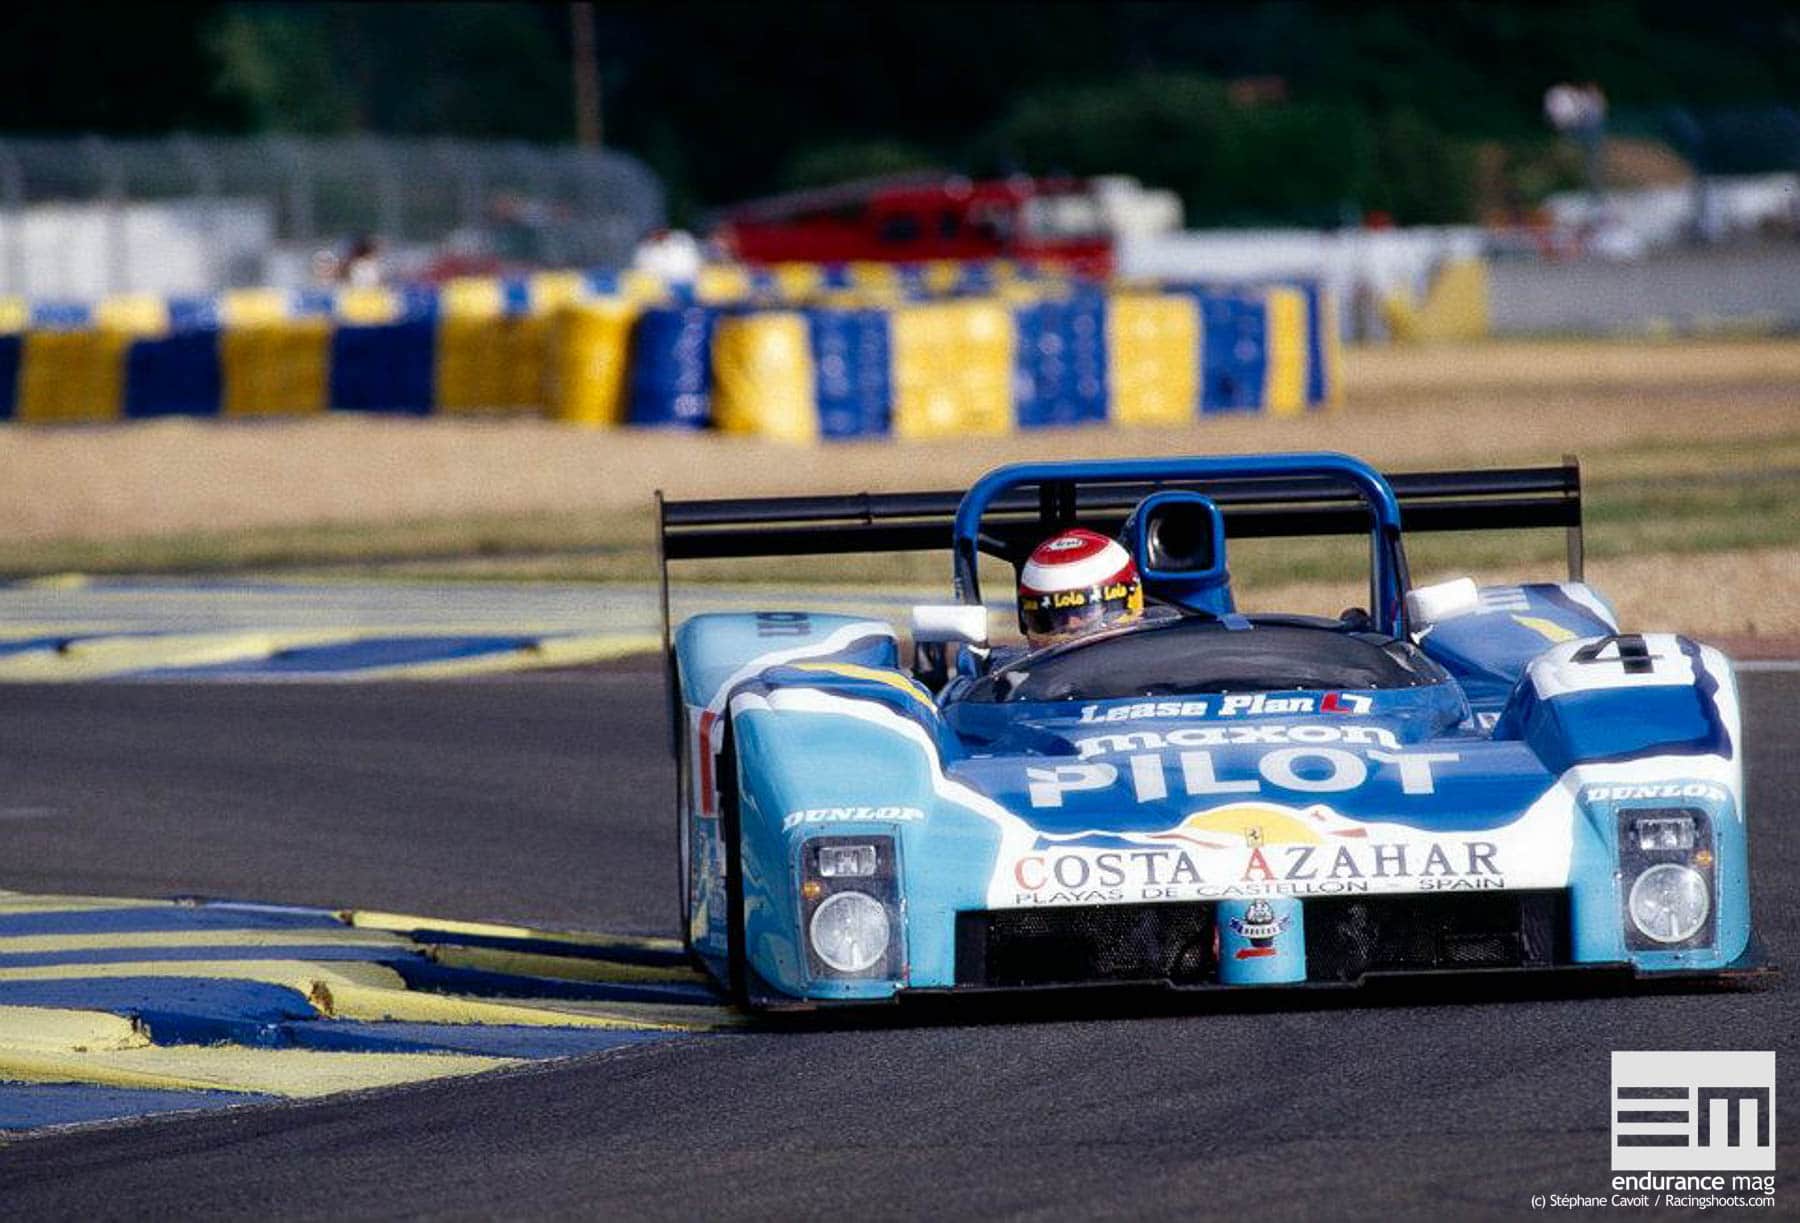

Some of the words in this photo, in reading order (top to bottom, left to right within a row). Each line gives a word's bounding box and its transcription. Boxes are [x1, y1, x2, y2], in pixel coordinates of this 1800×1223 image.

[1079, 702, 1208, 723] Lease
[1218, 693, 1314, 716] Plan
[1075, 725, 1402, 760] maxon
[1027, 747, 1460, 807] PILOT
[782, 807, 925, 834] DUNLOP
[1014, 850, 1205, 891] COSTA
[1241, 842, 1504, 882] AZAHAR
[1015, 888, 1124, 905] PLAYAS
[1142, 886, 1178, 899] DE
[1197, 881, 1368, 897] CASTELLON
[1419, 877, 1505, 890] SPAIN
